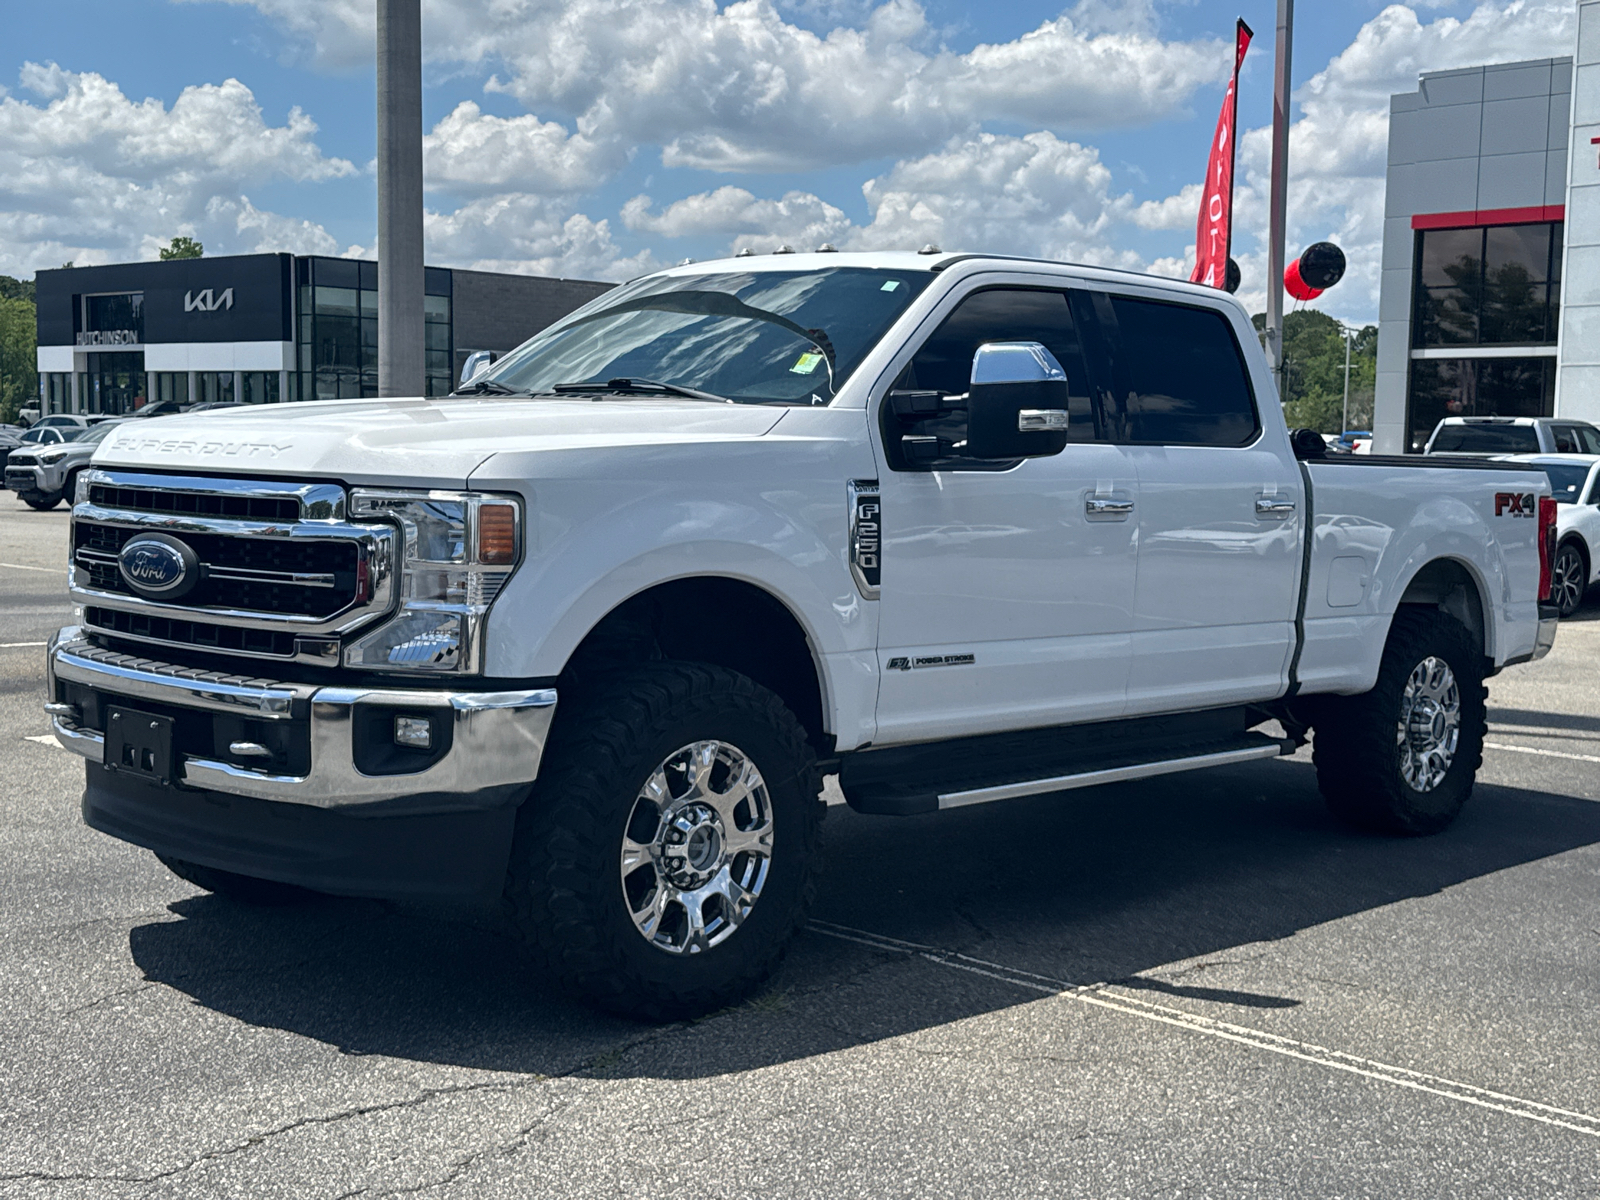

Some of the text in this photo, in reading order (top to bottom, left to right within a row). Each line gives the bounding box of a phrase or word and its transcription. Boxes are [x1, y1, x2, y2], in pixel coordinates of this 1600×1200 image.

[184, 287, 234, 312] KIA
[76, 329, 139, 346] HUTCHINSON
[111, 438, 294, 457] SUPER DUTY
[1495, 492, 1535, 517] FX4
[131, 550, 167, 580] Ford
